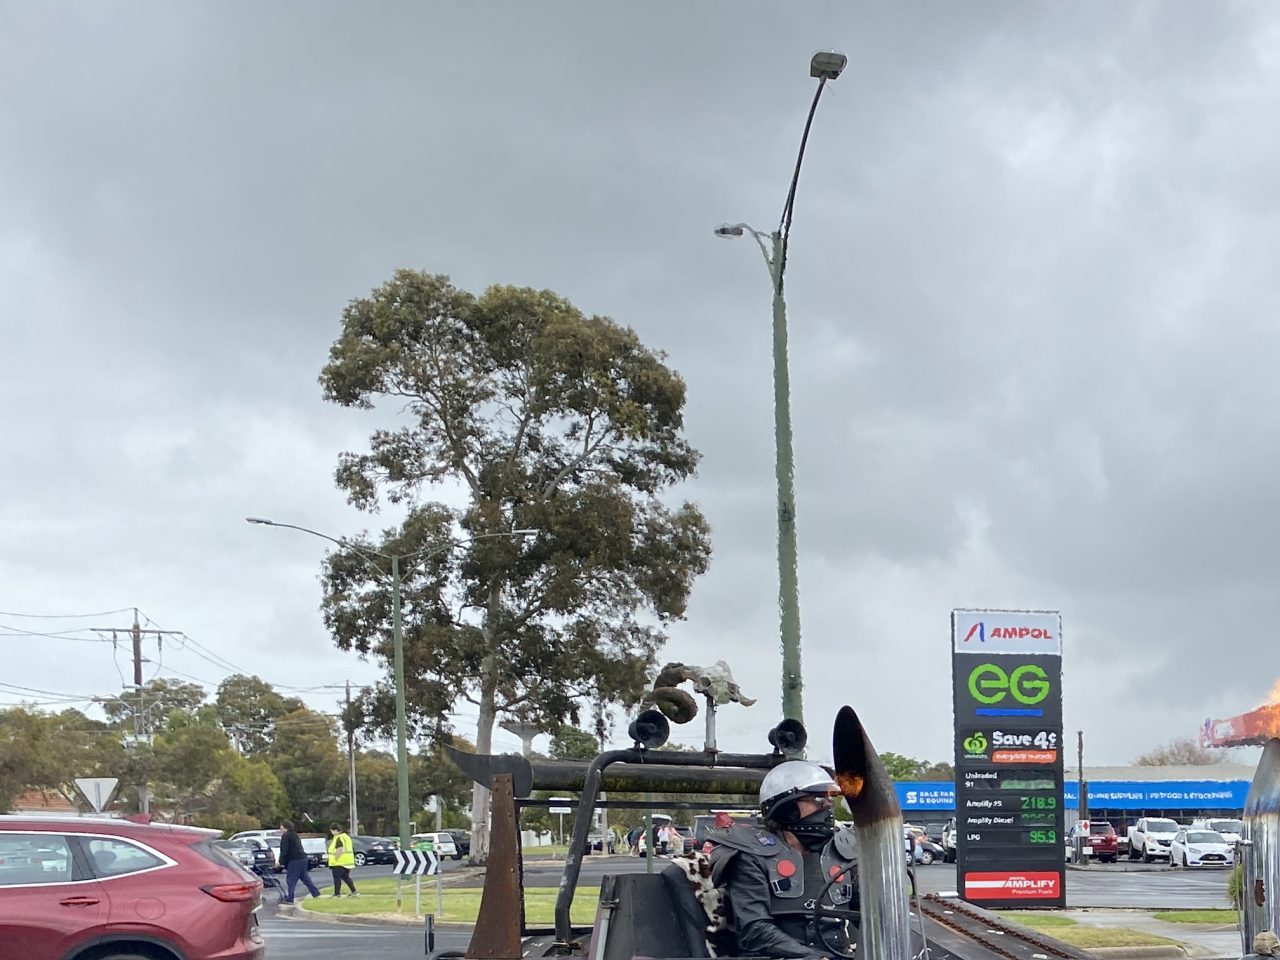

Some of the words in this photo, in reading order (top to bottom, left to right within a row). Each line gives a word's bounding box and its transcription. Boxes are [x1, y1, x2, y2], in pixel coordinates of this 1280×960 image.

[990, 626, 1053, 640] AMPOL
[992, 730, 1032, 746] Save
[966, 799, 993, 809] Amplify
[1020, 796, 1057, 810] 218.9
[966, 816, 993, 825] Amplify
[966, 833, 981, 841] LPG
[1029, 830, 1056, 844] 95.9
[1003, 879, 1056, 888] AMPLIFY
